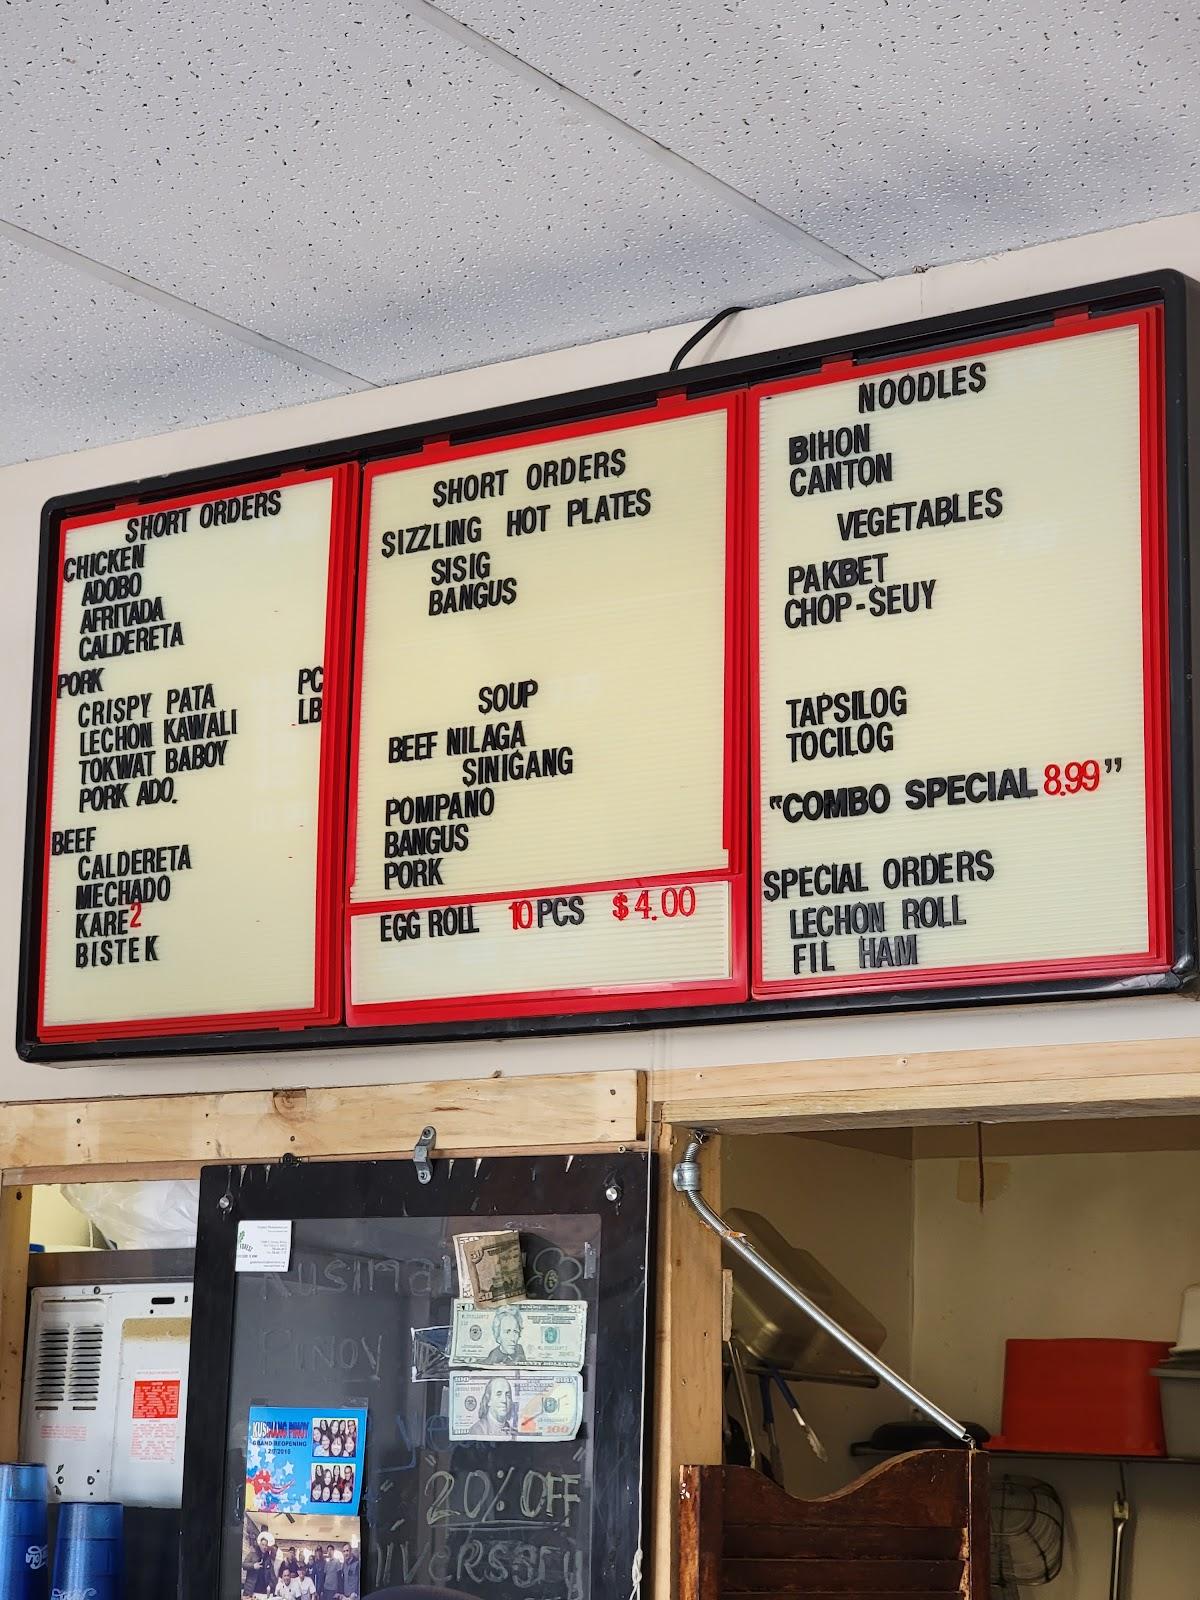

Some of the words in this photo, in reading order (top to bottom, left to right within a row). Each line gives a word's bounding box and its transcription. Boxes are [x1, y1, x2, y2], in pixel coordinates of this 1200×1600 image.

[858, 362, 986, 413] NOODLES
[788, 423, 871, 465] BIHON
[433, 469, 508, 508] SHORT
[526, 448, 626, 490] ORDERS
[790, 452, 893, 497] CANTON
[126, 508, 191, 542] SHORT
[200, 490, 281, 528] ORDERS
[381, 516, 482, 557] SIZZLING
[507, 505, 550, 536] HOT
[567, 488, 651, 527] PLATES
[837, 487, 1003, 541] VEGETABLES
[64, 544, 146, 582] CHICKEN
[431, 552, 491, 585] SISIG
[788, 552, 889, 595] PAKBET
[82, 573, 141, 606] ADOBO
[429, 578, 517, 616] BANGUS
[784, 579, 936, 629] CHOP-SEUY
[80, 597, 165, 634] AFRITADA
[79, 622, 184, 661] CALDERETA
[57, 668, 105, 698] PORK
[478, 679, 539, 714] SOUP
[78, 693, 152, 727] CRISPY
[167, 683, 216, 714] PATA
[786, 685, 907, 728] TAPSILOG
[80, 721, 153, 756] LECHON
[164, 709, 238, 743] KAWALI
[299, 697, 322, 724] LB
[388, 731, 438, 763] BEEF
[447, 720, 527, 756] NILAGA
[786, 721, 894, 763] TOCILOG
[79, 750, 156, 784] TOKWAT
[166, 740, 228, 774] BABOY
[462, 747, 573, 787] SINIGANG
[79, 782, 129, 812] PORK
[137, 777, 178, 806] ADO.
[386, 787, 495, 826] POMPANO
[905, 767, 1038, 810] SPECIAL
[52, 827, 96, 855] BEEF
[385, 823, 469, 858] BANGUS
[78, 845, 192, 880] CALDERETA
[384, 858, 444, 889] PORK
[763, 862, 869, 901] SPECIAL
[883, 849, 995, 889] ORDERS
[76, 875, 171, 910] MECHADO
[380, 910, 421, 942] EGG
[428, 904, 479, 938] ROLL
[612, 886, 697, 921] $4.00
[790, 901, 885, 939] LECHON
[902, 894, 967, 930] ROLL
[75, 936, 160, 968] BISTEK
[793, 940, 835, 975] FIL
[858, 934, 918, 968] HAM
[424, 1467, 515, 1526] 20%
[519, 1470, 581, 1527] OFF
